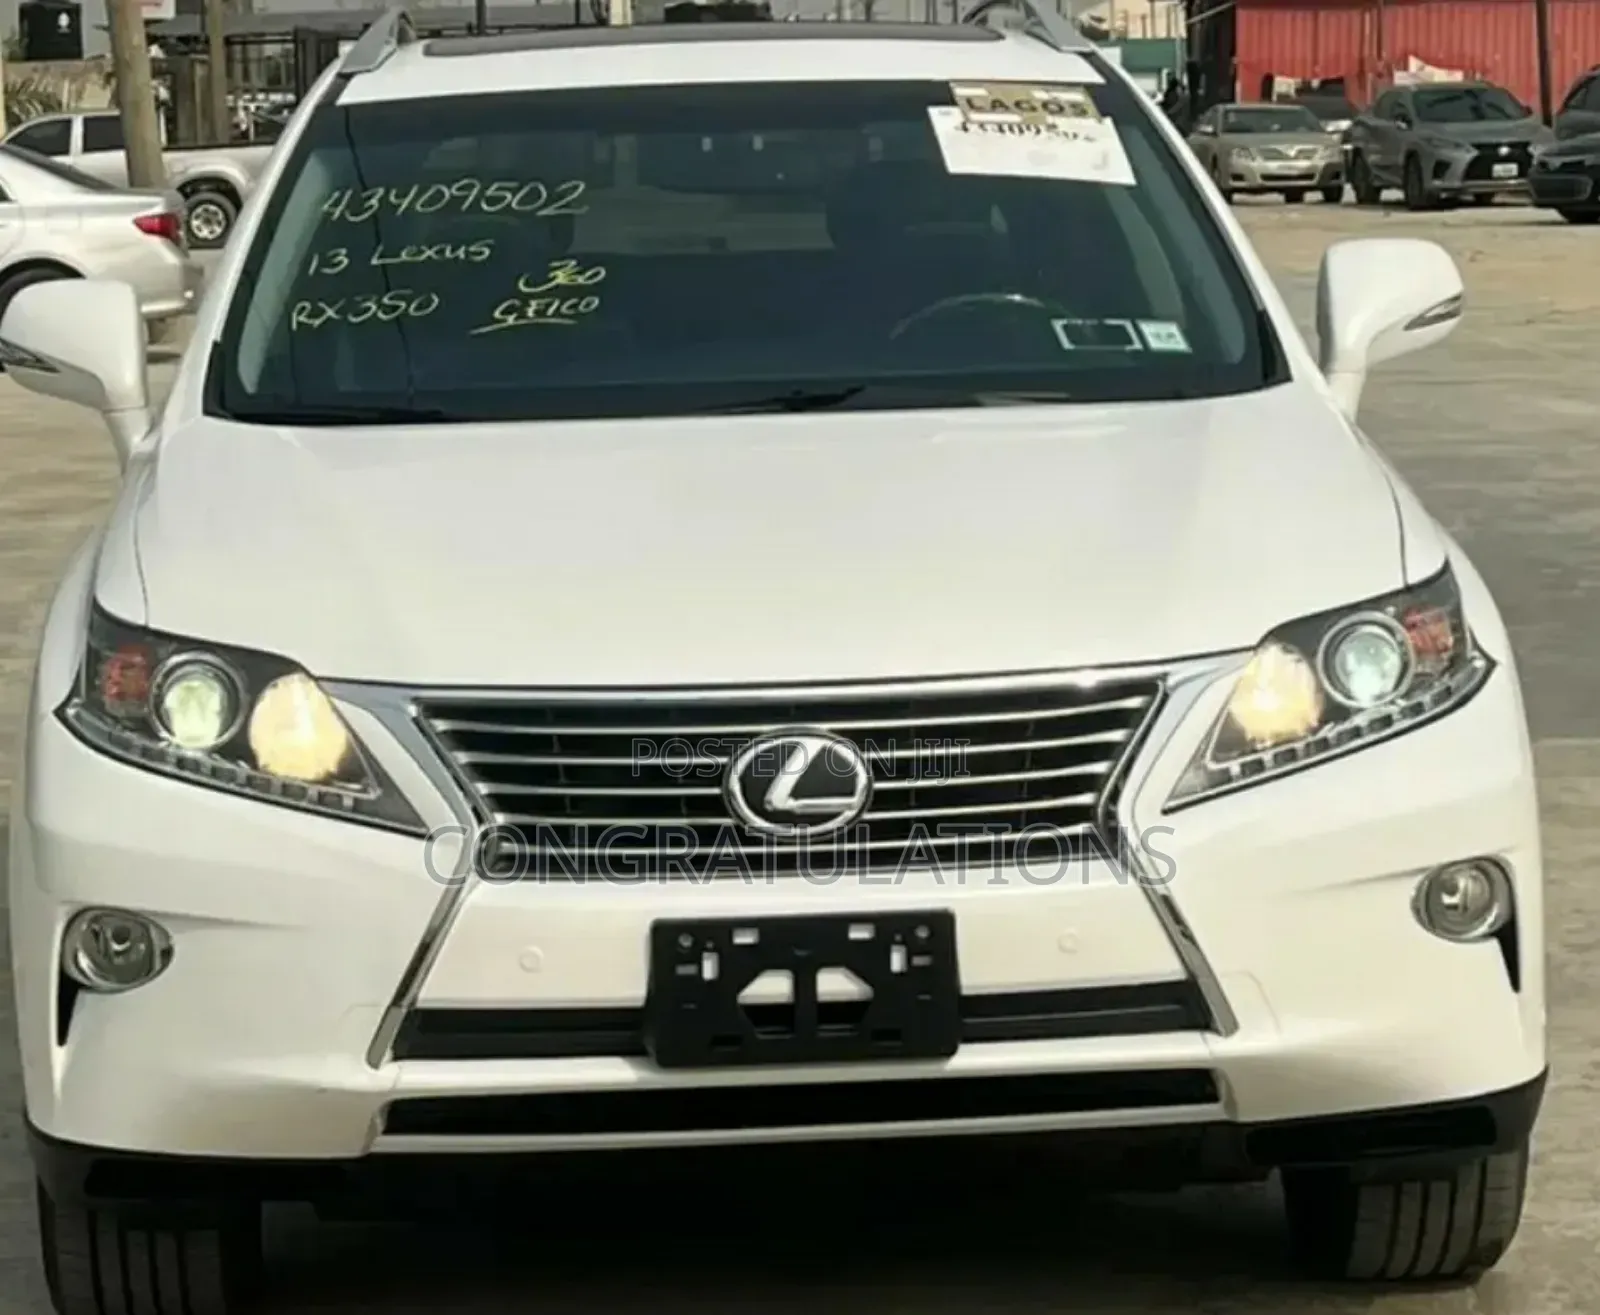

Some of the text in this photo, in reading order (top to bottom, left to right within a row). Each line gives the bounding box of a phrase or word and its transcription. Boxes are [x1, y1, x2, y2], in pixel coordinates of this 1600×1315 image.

[322, 178, 590, 223] 43409502
[308, 248, 350, 276] 13
[290, 291, 439, 331] RX350
